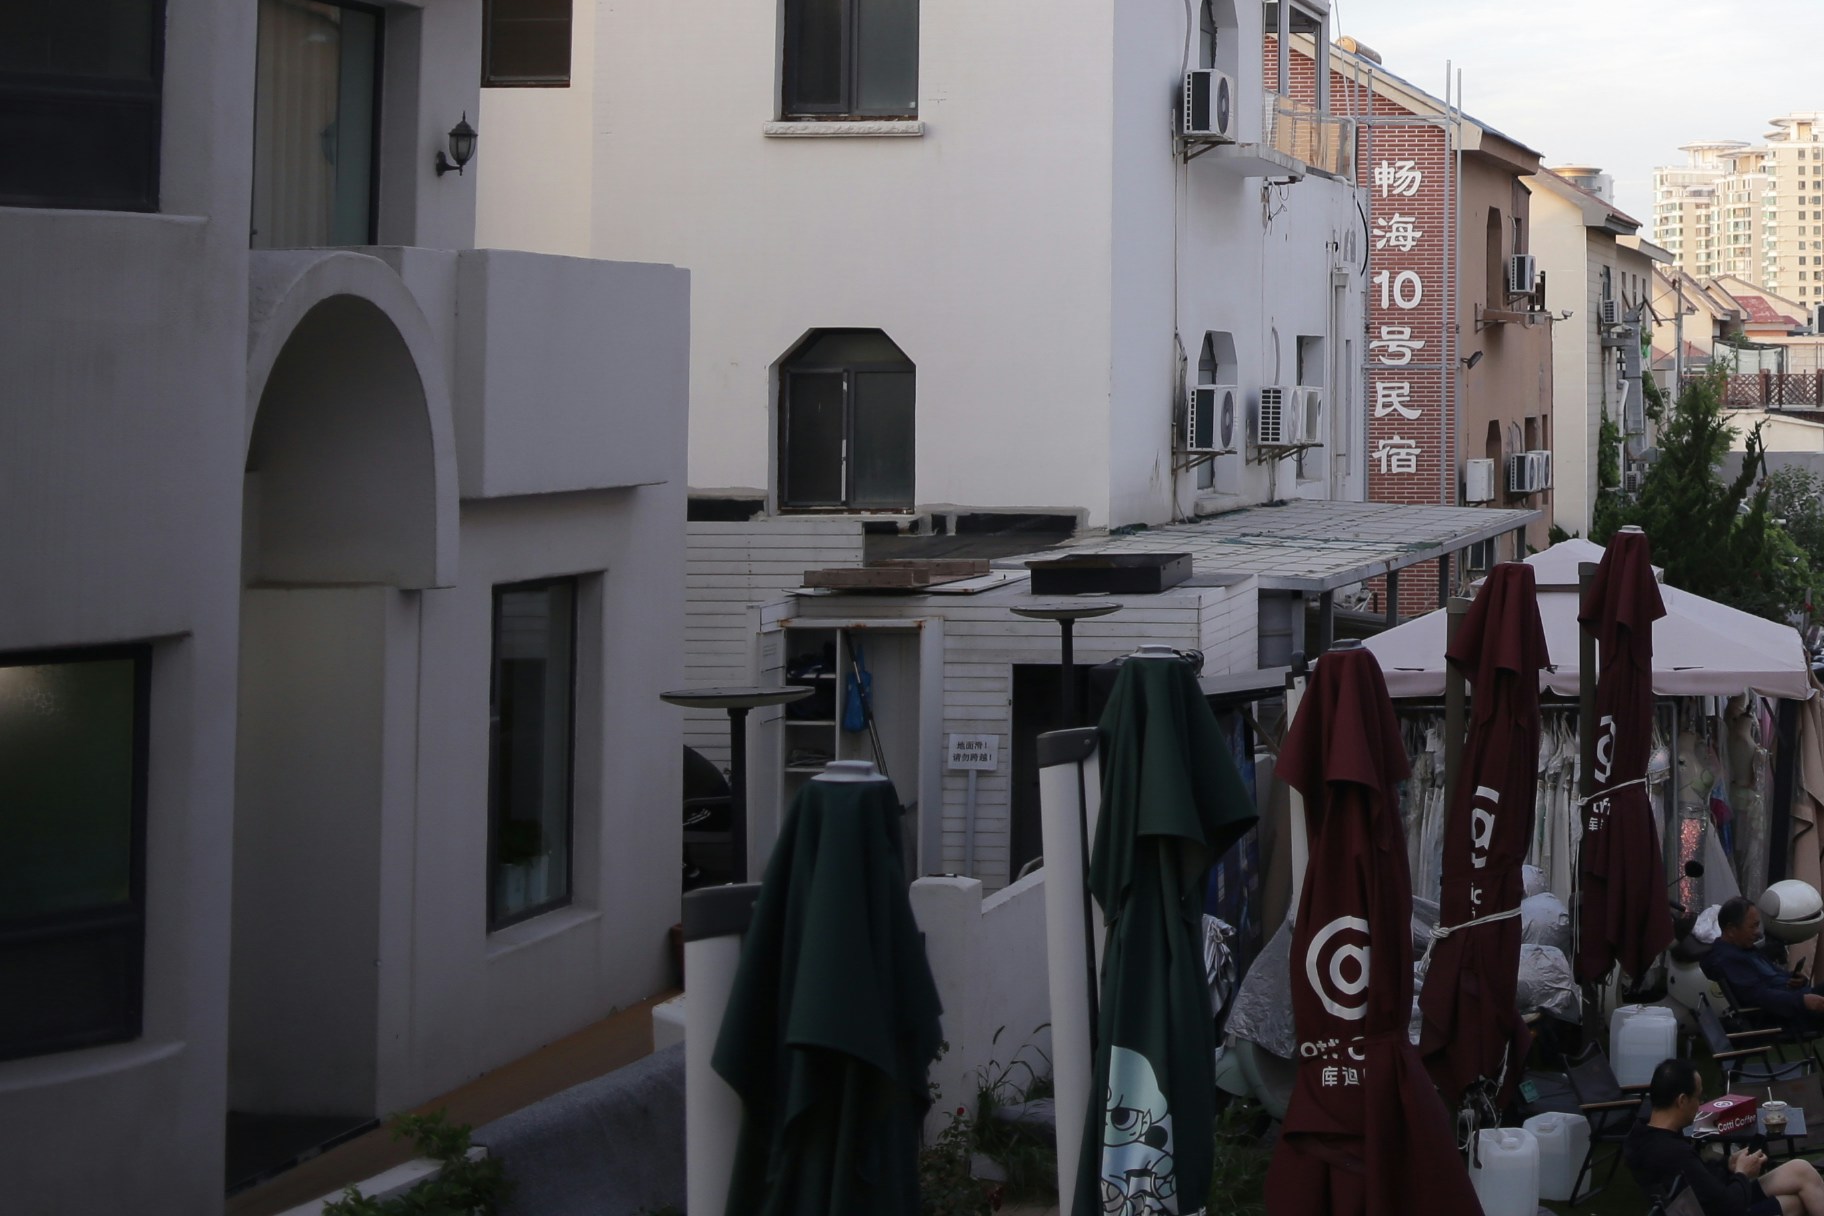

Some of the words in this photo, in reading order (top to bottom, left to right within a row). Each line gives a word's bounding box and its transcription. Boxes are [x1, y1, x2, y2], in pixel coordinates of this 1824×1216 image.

[1370, 160, 1425, 475] 畅海10号民宿
[1322, 1065, 1366, 1086] 库迪
[1717, 1119, 1734, 1133] Cotti
[1734, 1114, 1757, 1127] Coffee
